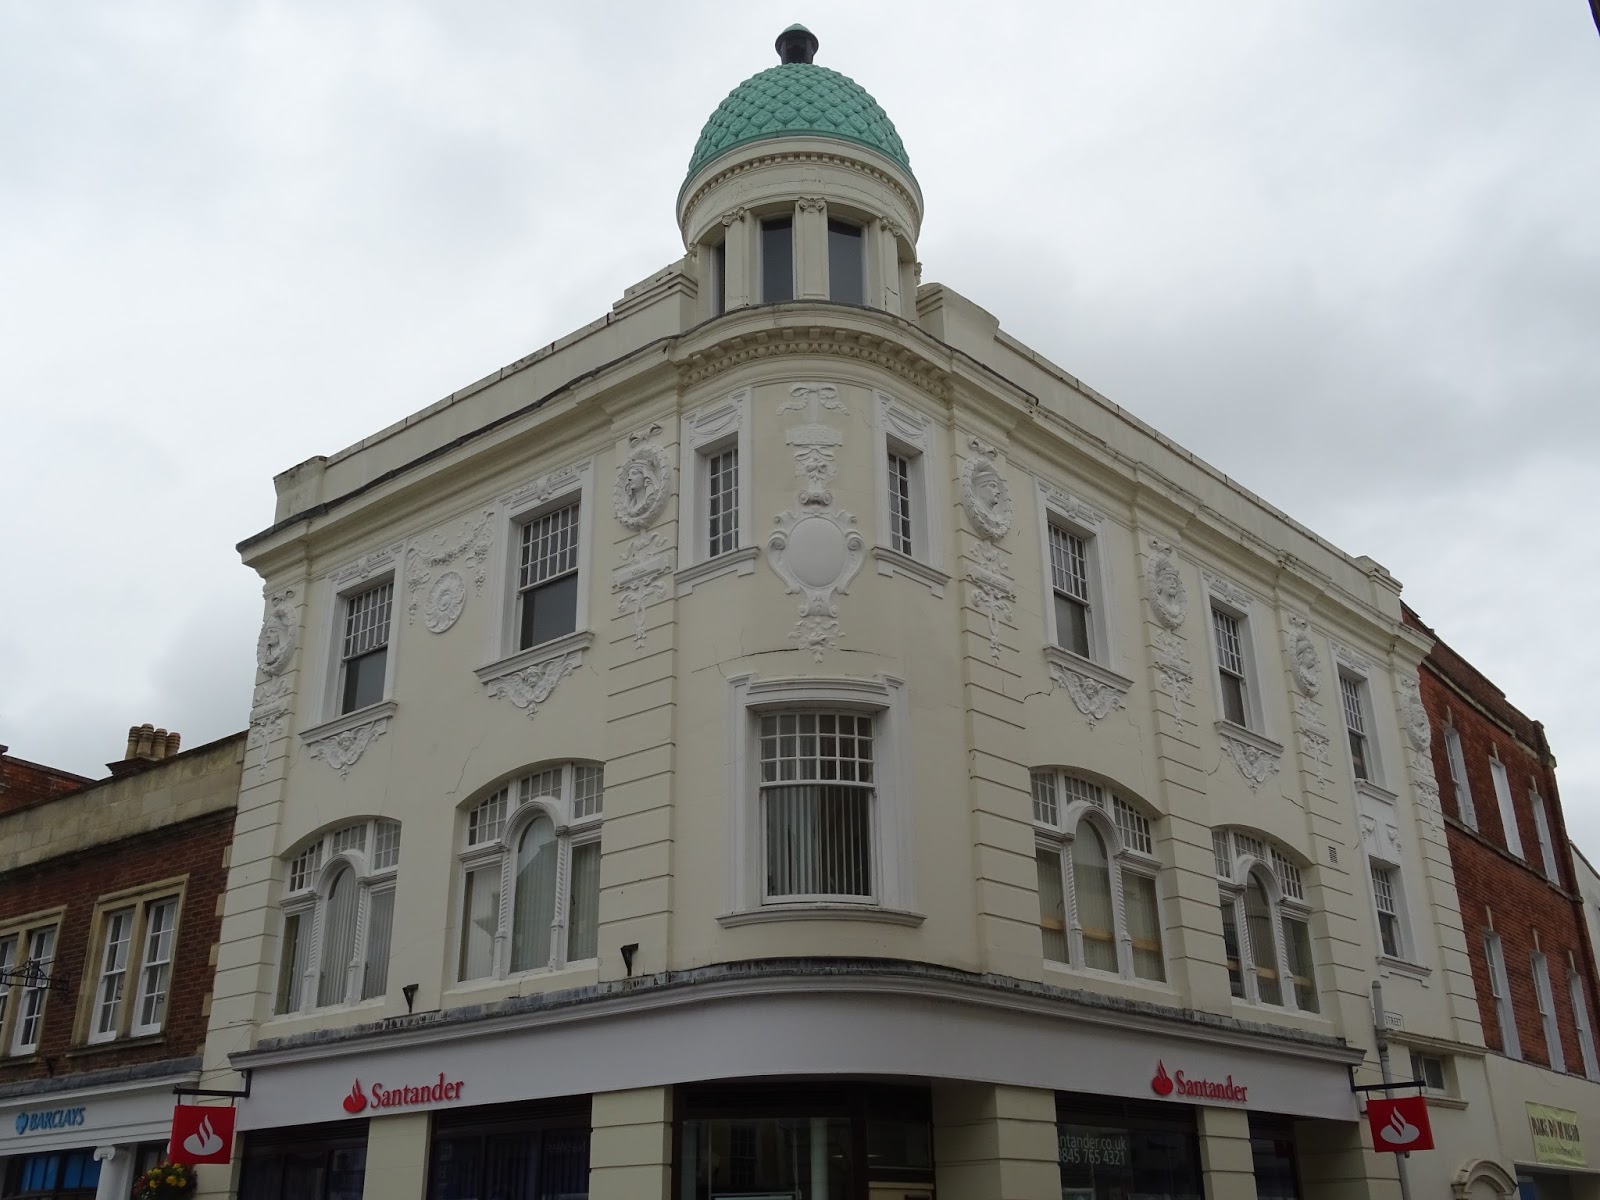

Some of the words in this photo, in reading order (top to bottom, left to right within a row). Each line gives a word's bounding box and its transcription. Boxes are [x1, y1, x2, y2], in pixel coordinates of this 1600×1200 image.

[370, 1072, 464, 1109] Santander
[1175, 1069, 1248, 1102] Santander
[29, 1107, 86, 1130] BARCLAYS
[1058, 1132, 1127, 1151] ntander.co.uk
[1083, 1149, 1101, 1165] 765
[1103, 1150, 1125, 1166] 4321
